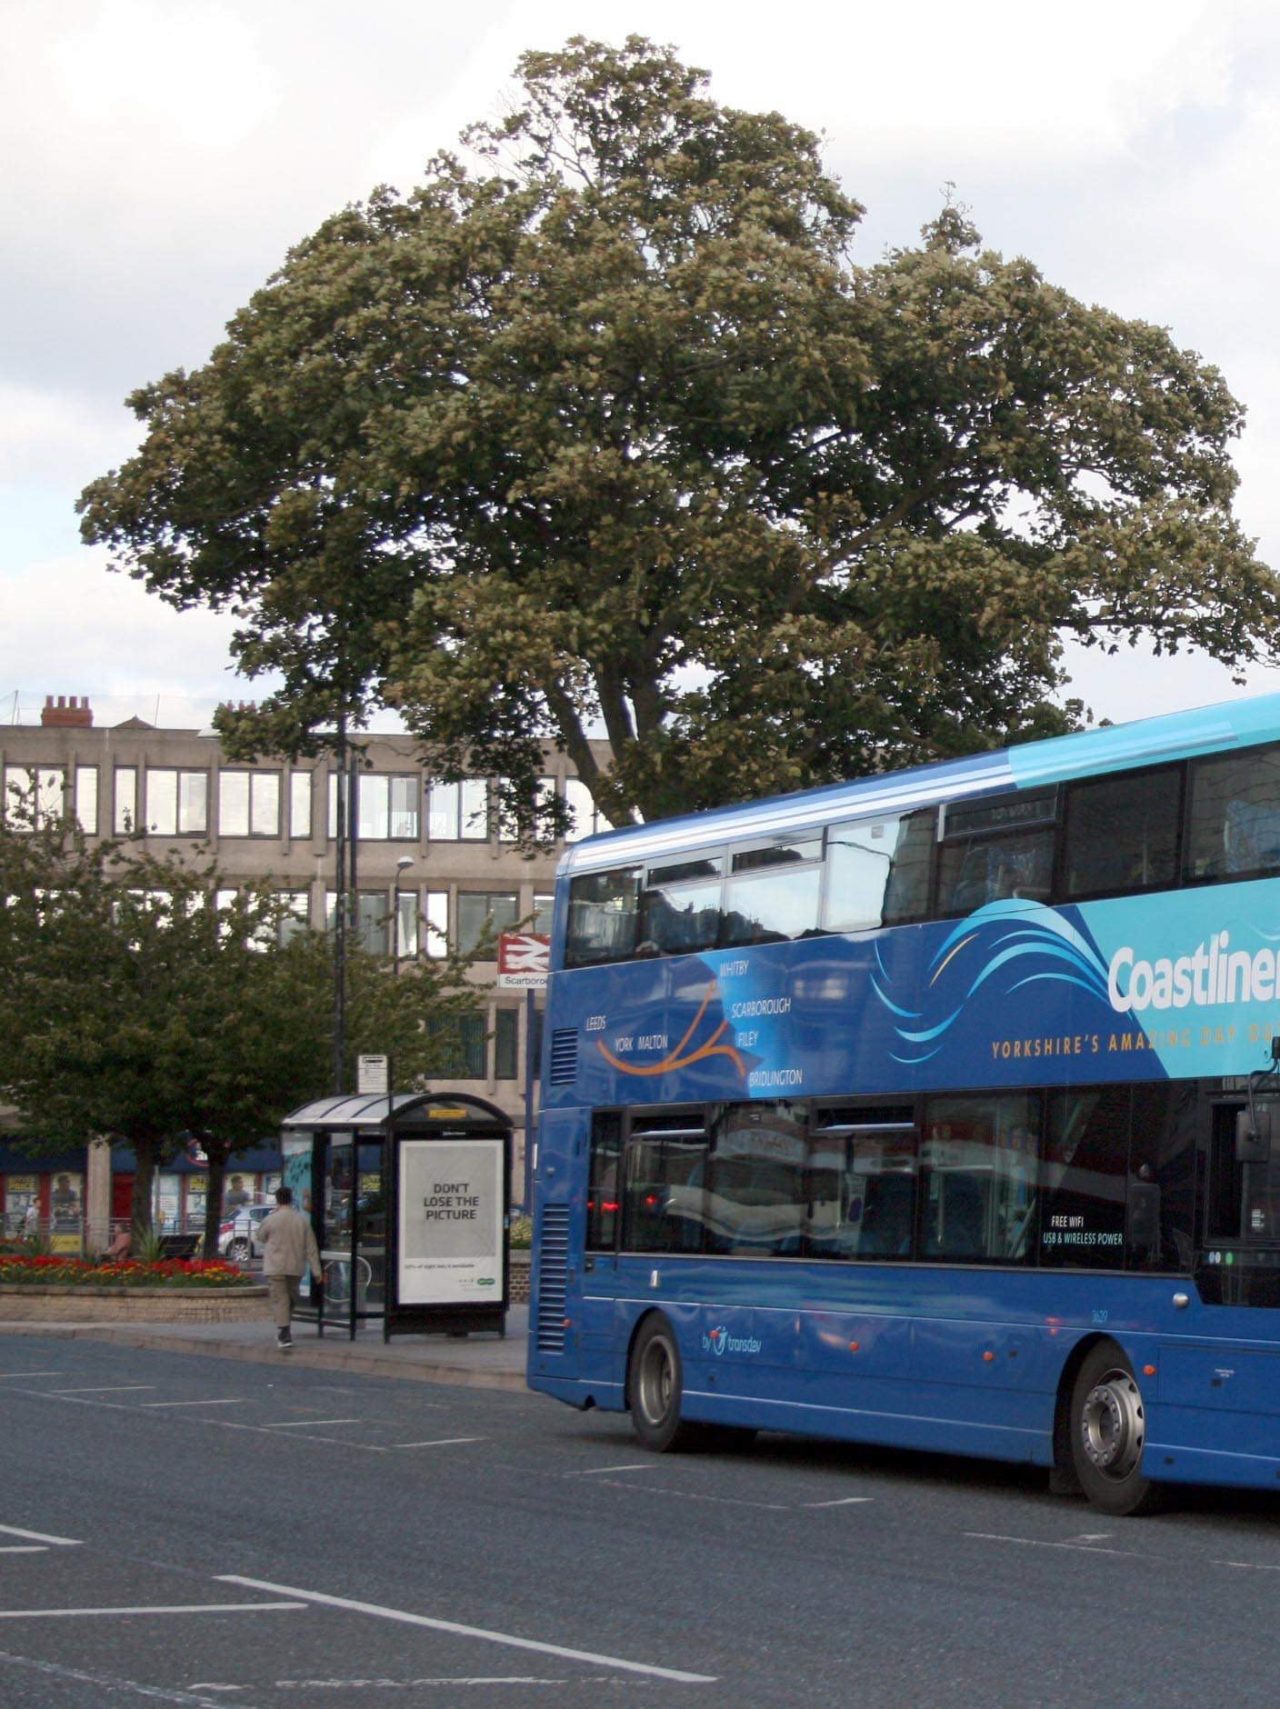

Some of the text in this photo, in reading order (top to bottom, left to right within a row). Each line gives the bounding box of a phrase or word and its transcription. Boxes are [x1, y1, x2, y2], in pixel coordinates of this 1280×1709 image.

[720, 960, 750, 978] WHITBY
[505, 975, 546, 985] Scarboro
[732, 998, 791, 1019] SCARBOROUGH
[585, 1015, 607, 1031] LEEDS
[615, 1034, 668, 1052] YORK MALTON
[738, 1031, 759, 1047] FILEY
[991, 1034, 1100, 1060] YORKSHIRE'S
[749, 1069, 803, 1087] BRIDLINGTON
[433, 1183, 470, 1194] DON'T
[423, 1196, 479, 1207] LOSE THE
[426, 1209, 477, 1220] PICTURE
[1051, 1215, 1084, 1229] FREE WIFI
[1043, 1232, 1123, 1246] USB & WIRELESS POWER
